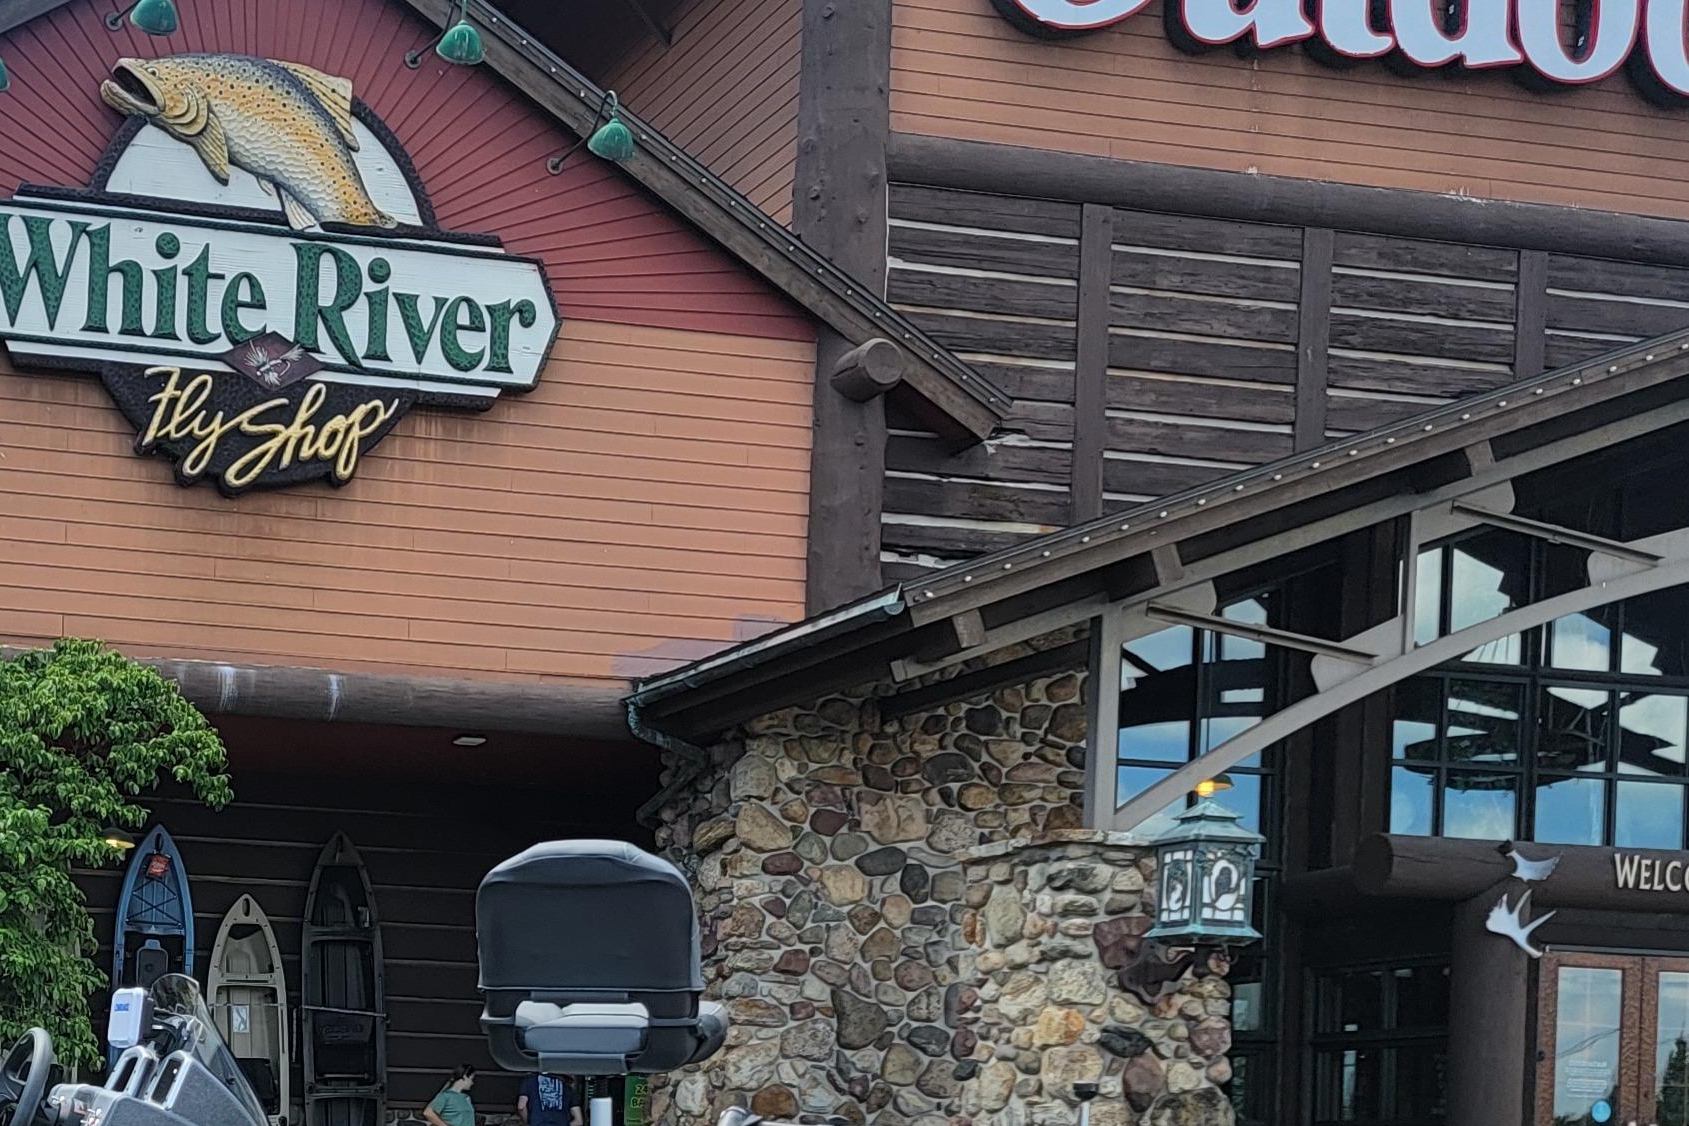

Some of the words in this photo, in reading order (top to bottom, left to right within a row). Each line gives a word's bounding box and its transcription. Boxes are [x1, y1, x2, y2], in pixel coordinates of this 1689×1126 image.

[289, 243, 537, 374] River
[142, 367, 225, 477] Fly
[224, 383, 400, 487] Shop
[1614, 853, 1689, 892] WELC
